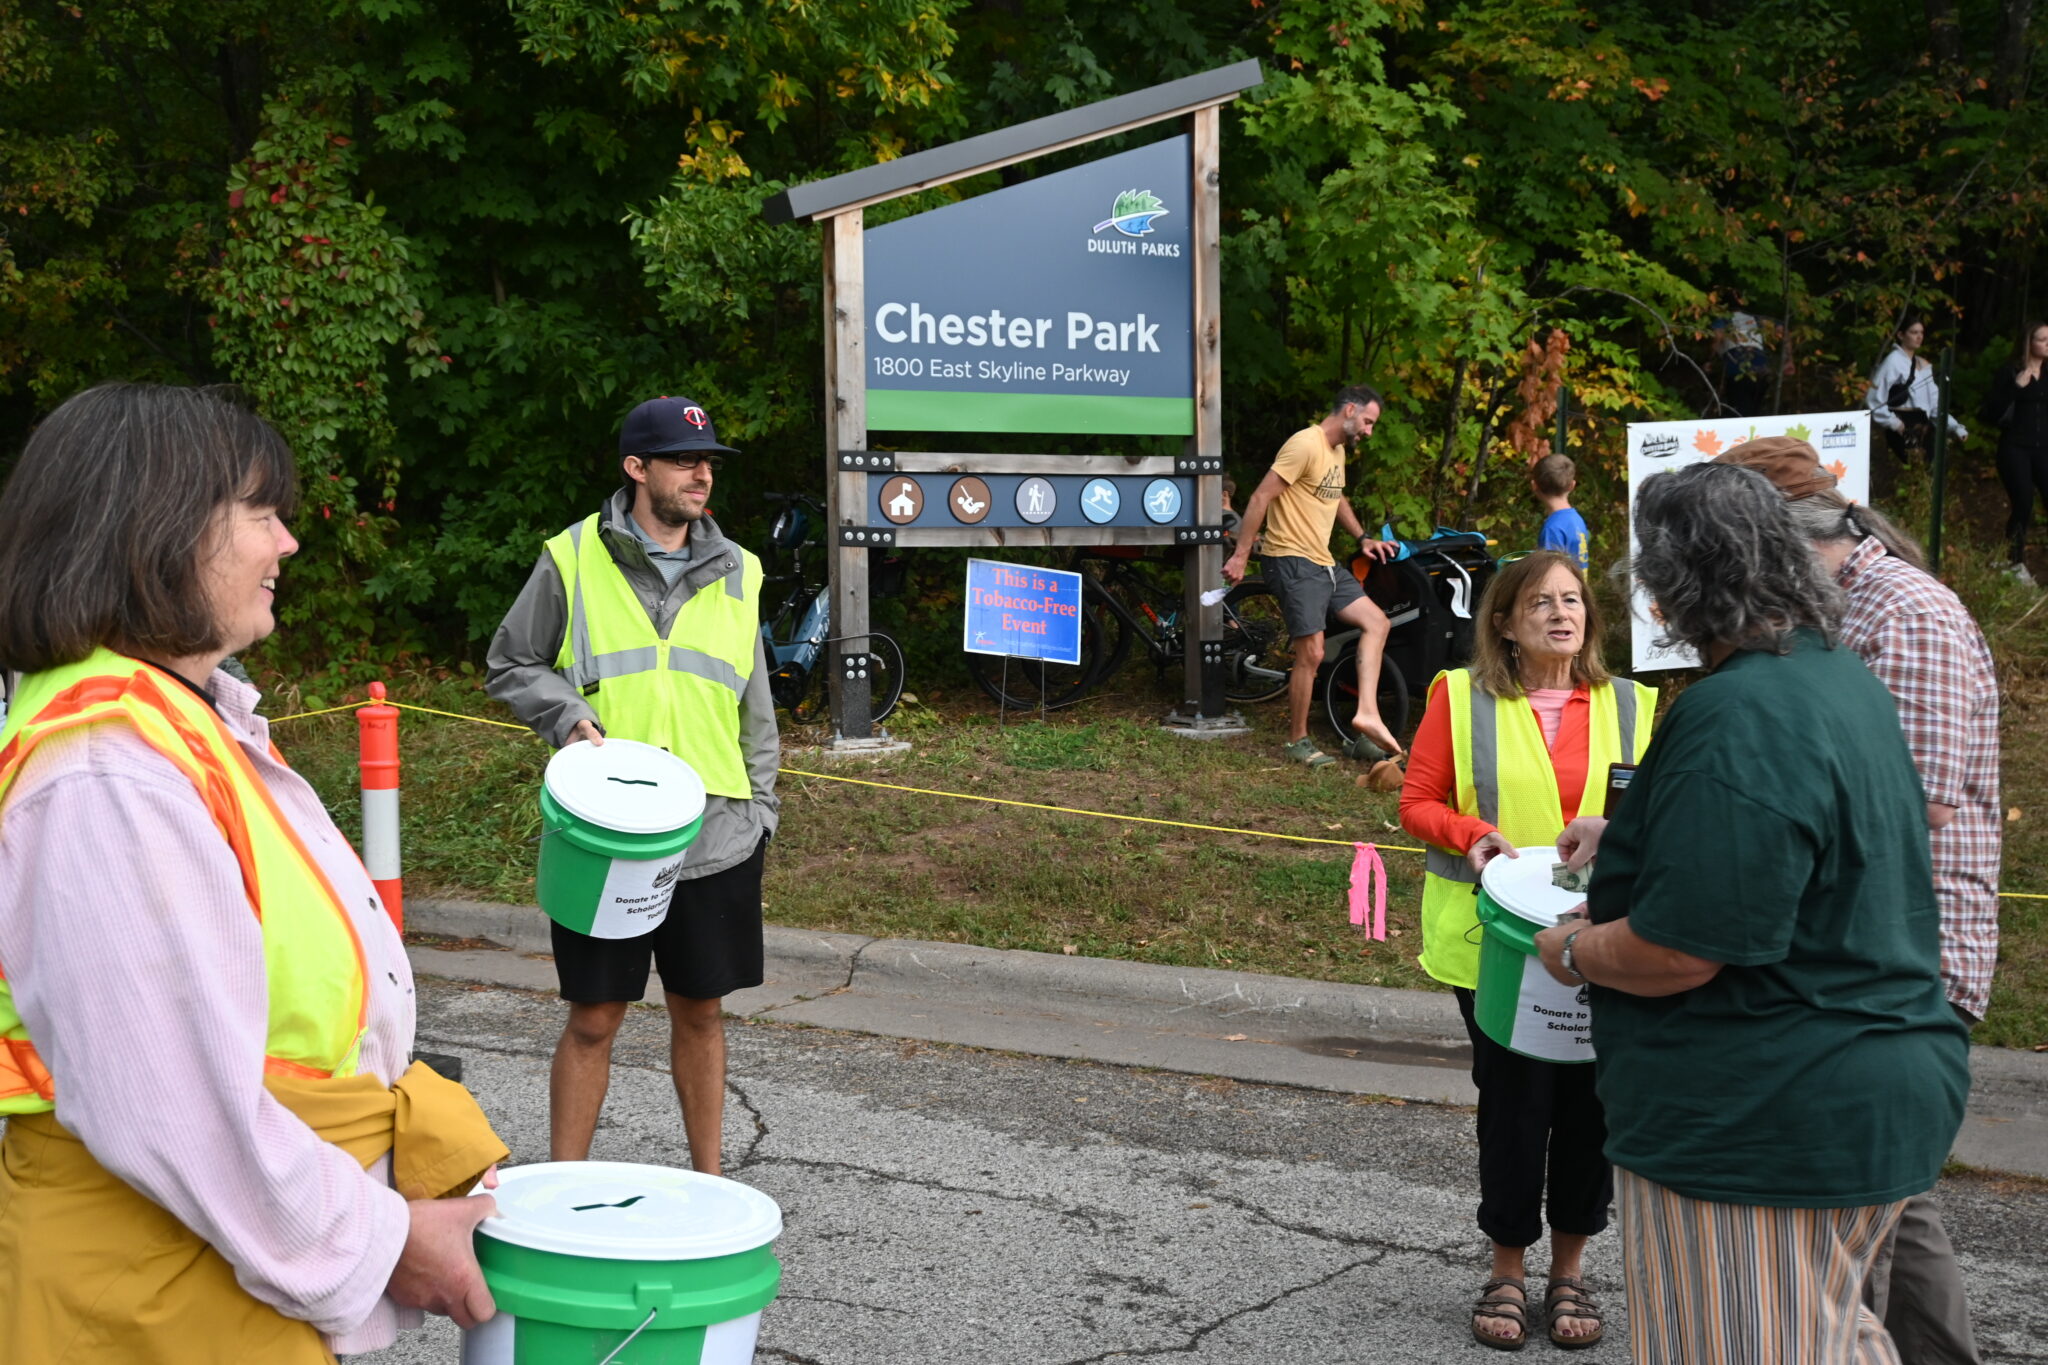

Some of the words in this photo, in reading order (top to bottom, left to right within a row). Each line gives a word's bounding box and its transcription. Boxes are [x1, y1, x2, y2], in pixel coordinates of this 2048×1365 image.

[1087, 239, 1137, 255] DULUTH
[1141, 242, 1180, 257] PARKS
[874, 301, 1052, 349] Chester
[1067, 311, 1161, 353] Park
[874, 356, 923, 377] 1800
[930, 358, 972, 379] East
[978, 360, 1046, 382] Skyline
[1052, 362, 1130, 386] Parkway
[992, 567, 1028, 588] This
[1032, 573, 1046, 590] is
[1049, 580, 1058, 592] a
[971, 587, 1078, 617] Tobacco-Free
[1001, 613, 1048, 635] Event
[615, 896, 649, 904] Donate
[1533, 1004, 1573, 1019] Donate
[1576, 1011, 1588, 1019] to
